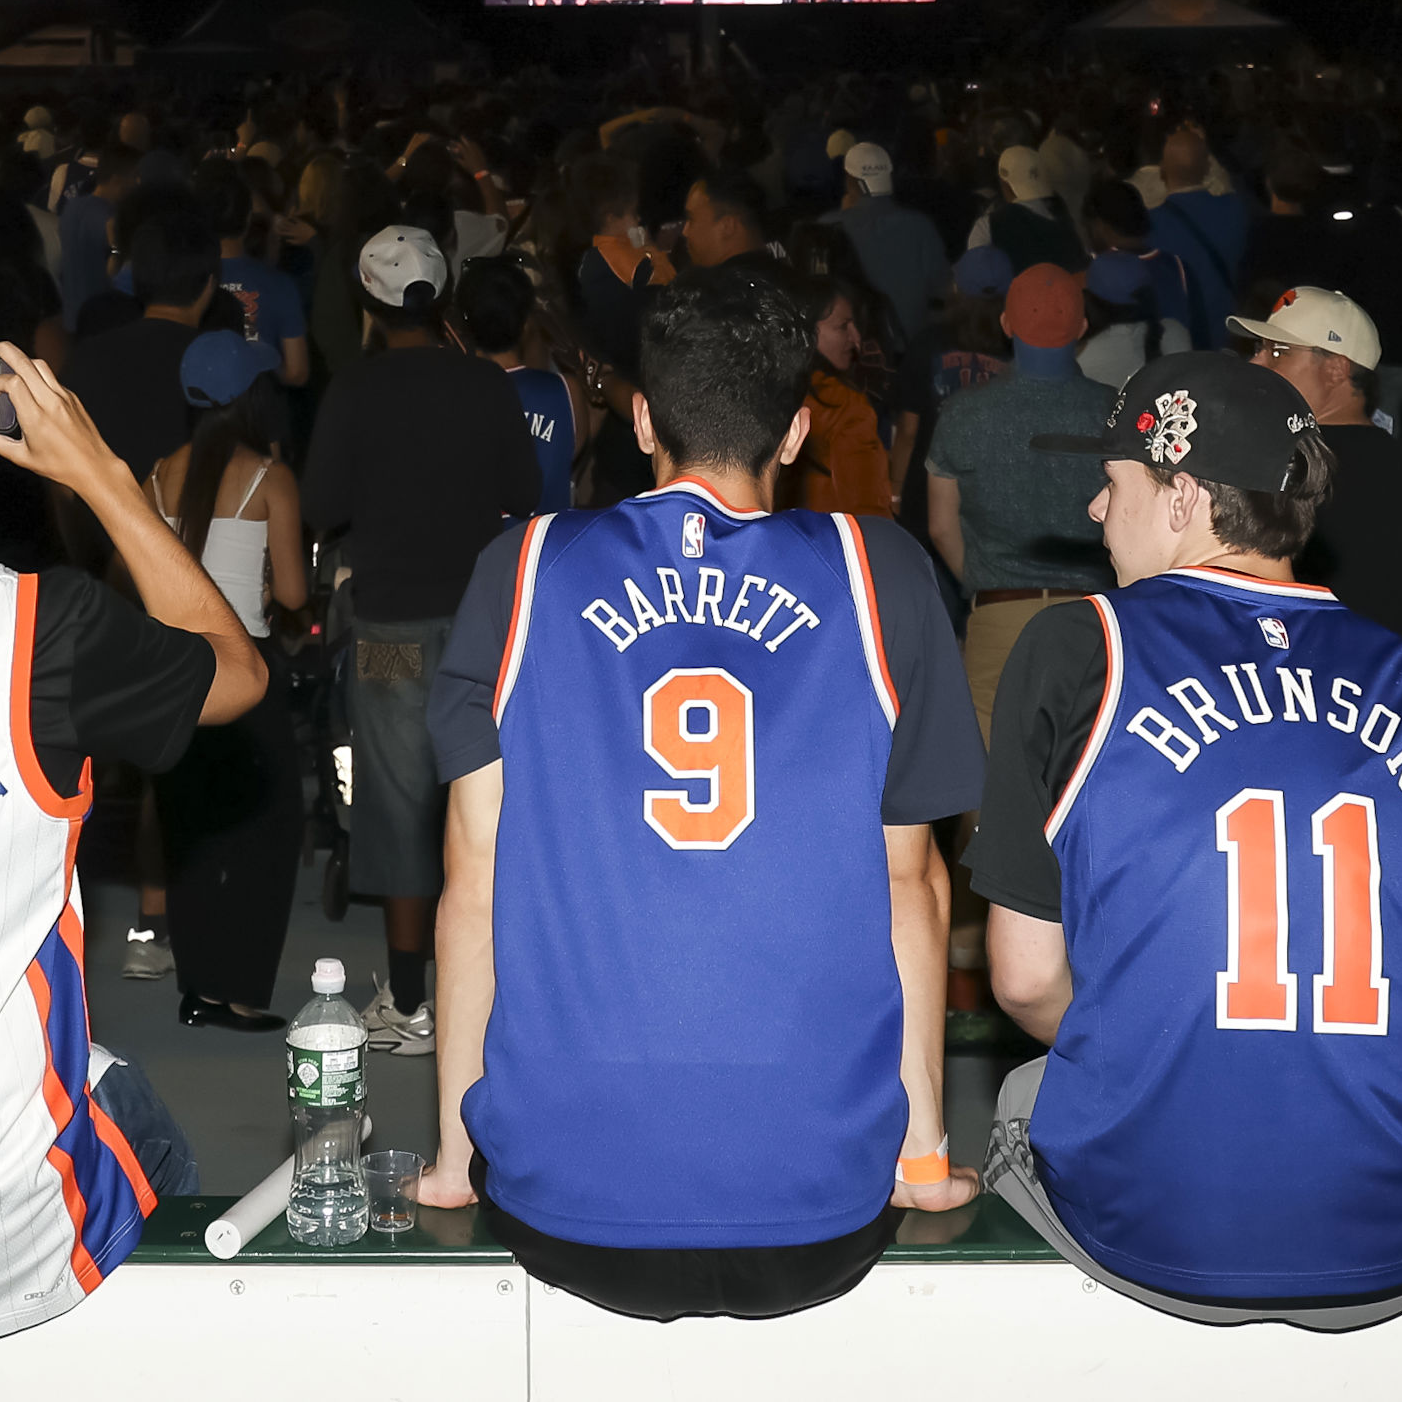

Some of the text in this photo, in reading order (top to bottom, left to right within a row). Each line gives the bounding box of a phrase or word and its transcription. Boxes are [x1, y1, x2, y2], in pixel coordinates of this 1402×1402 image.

[581, 565, 821, 654] BARRETT
[642, 667, 755, 852] 9
[1215, 787, 1389, 1036] 11
